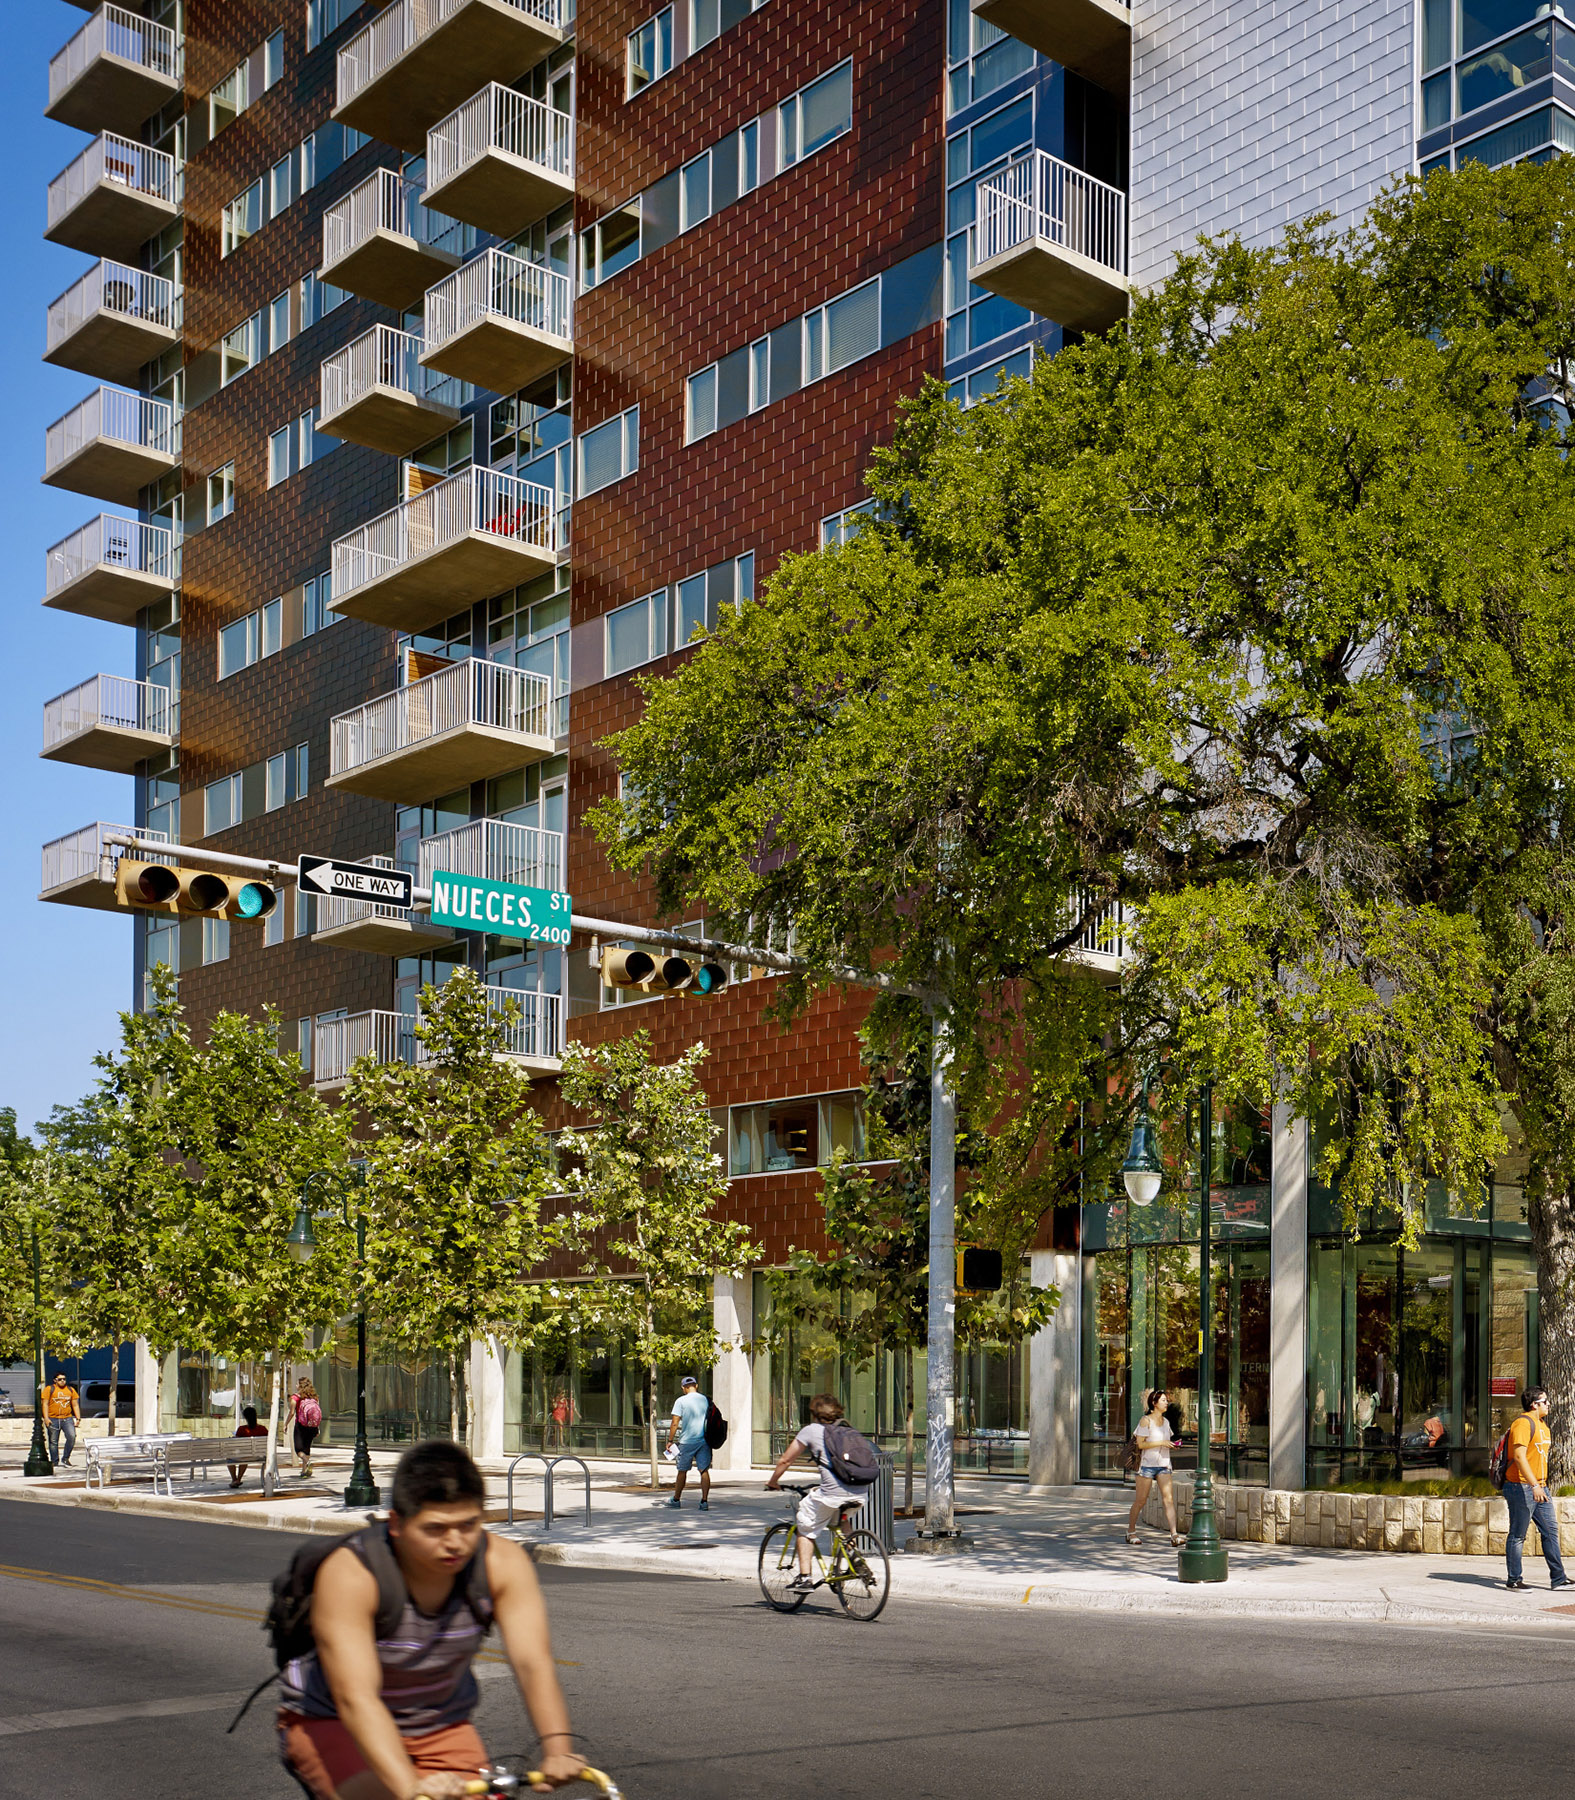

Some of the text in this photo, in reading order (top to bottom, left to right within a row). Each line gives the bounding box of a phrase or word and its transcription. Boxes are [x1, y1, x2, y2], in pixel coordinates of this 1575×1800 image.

[334, 872, 401, 896] ONE WAY
[433, 881, 570, 928] NUECES ST
[530, 924, 570, 944] 2400
